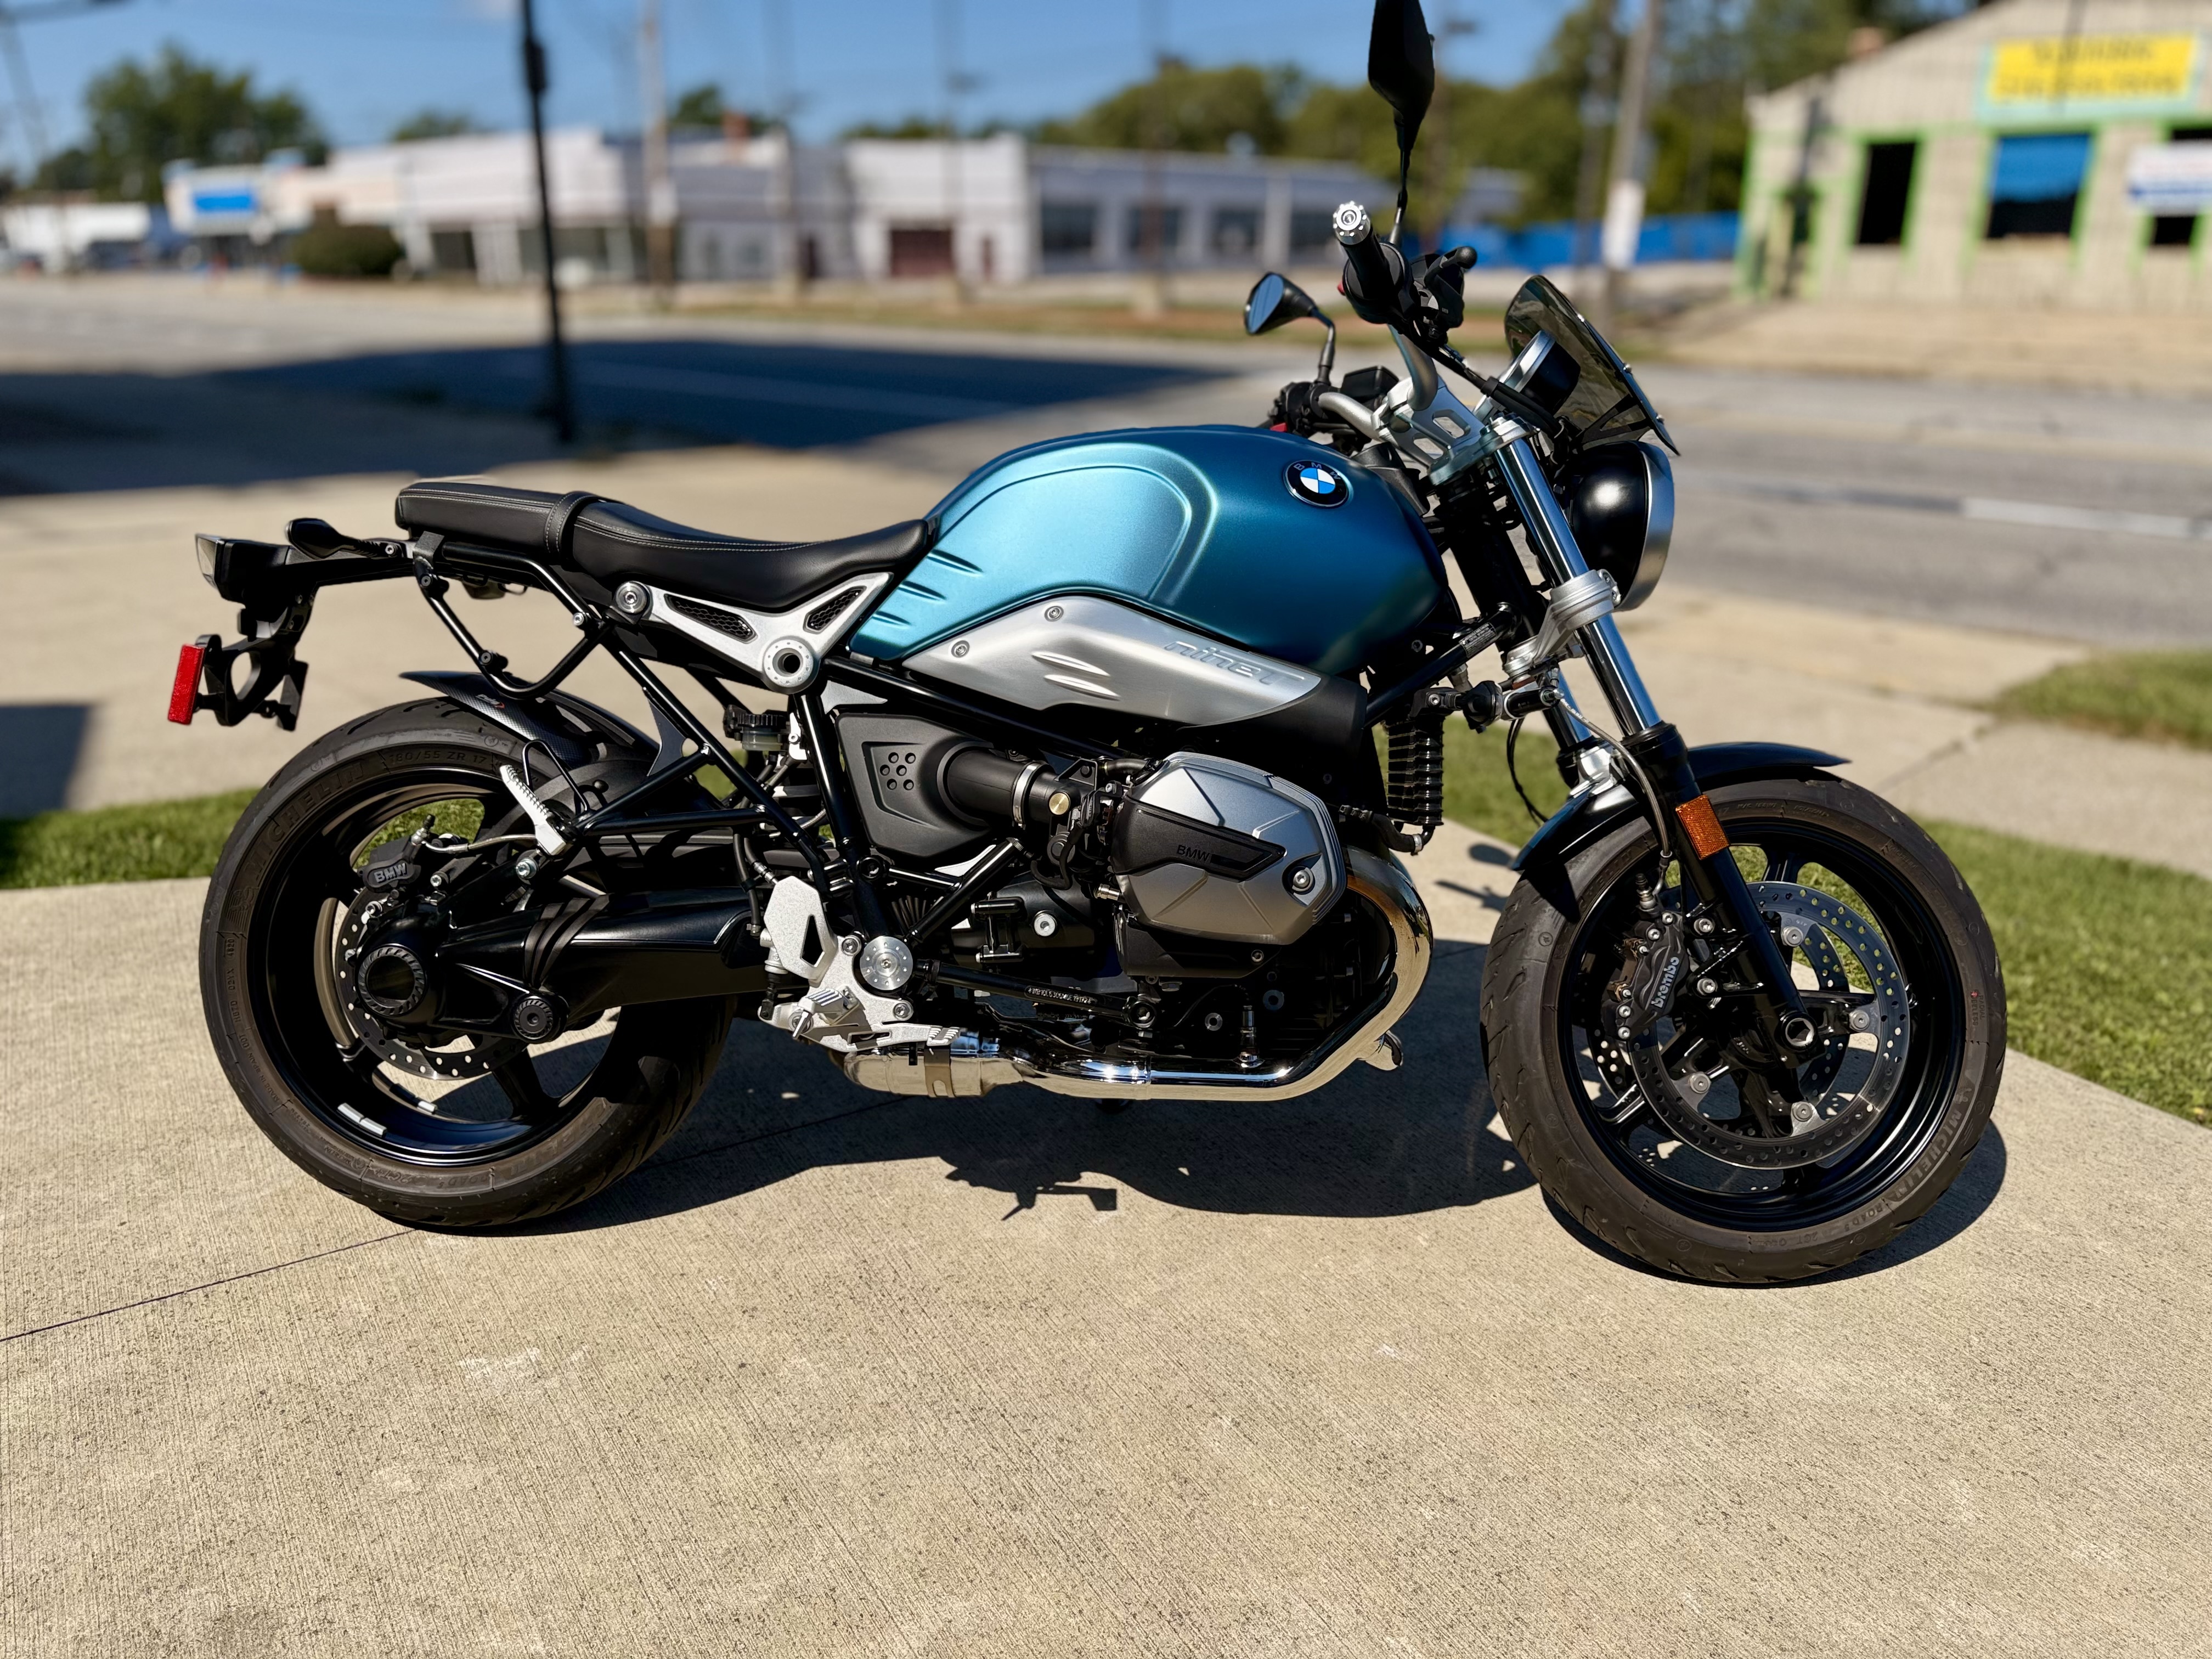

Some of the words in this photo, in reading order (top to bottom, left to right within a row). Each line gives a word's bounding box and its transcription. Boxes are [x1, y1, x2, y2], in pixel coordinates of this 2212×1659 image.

[1293, 462, 1341, 480] BMW
[1164, 641, 1305, 685] nineT
[447, 751, 465, 761] ZR
[472, 755, 487, 765] 17
[245, 758, 364, 880] MICHELIN
[1176, 844, 1211, 863] BMW
[374, 862, 407, 883] BMW
[1651, 957, 1679, 1008] brembo
[1893, 1109, 1962, 1201] MICHELIN
[1853, 1203, 1883, 1226] ROAD
